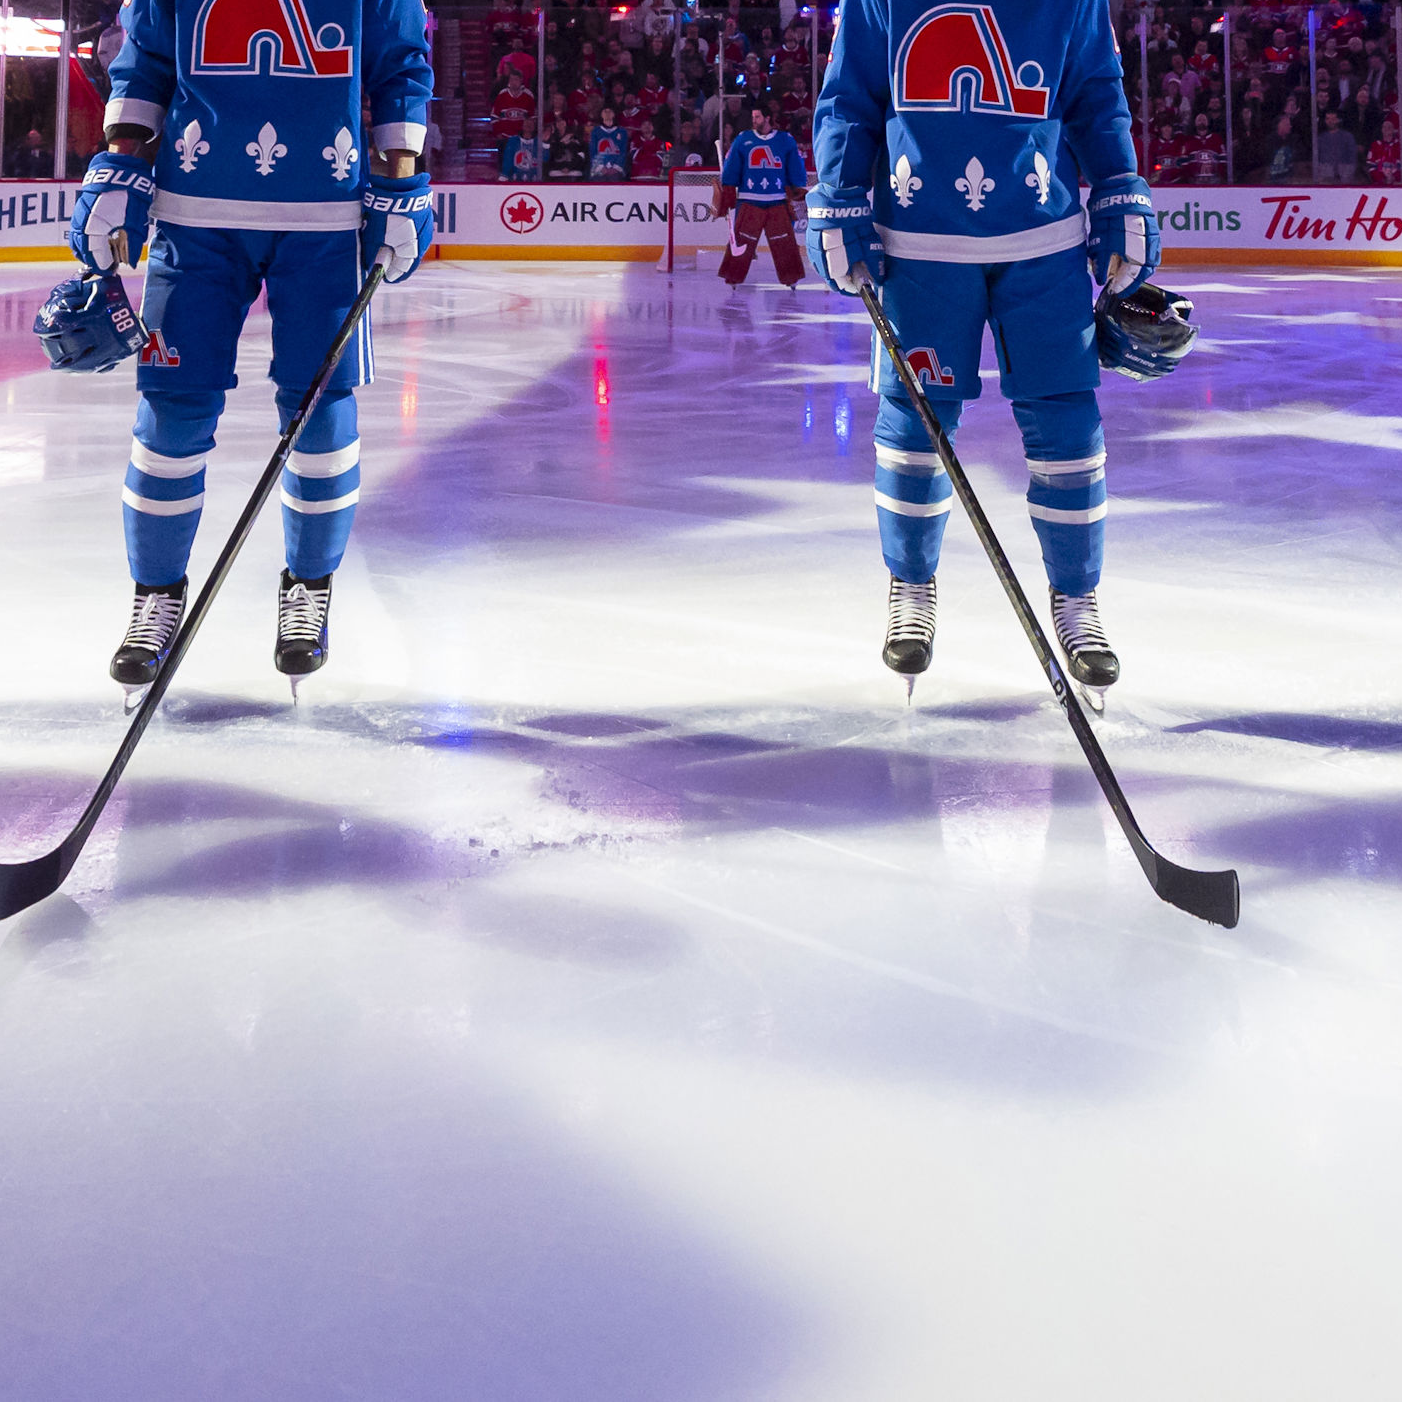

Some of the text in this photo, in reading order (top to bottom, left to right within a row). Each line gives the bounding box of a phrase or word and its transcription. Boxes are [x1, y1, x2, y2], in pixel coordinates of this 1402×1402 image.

[551, 201, 596, 222] AIR
[1158, 202, 1241, 231] rdins
[1261, 195, 1337, 240] Tim
[111, 307, 135, 334] 88
